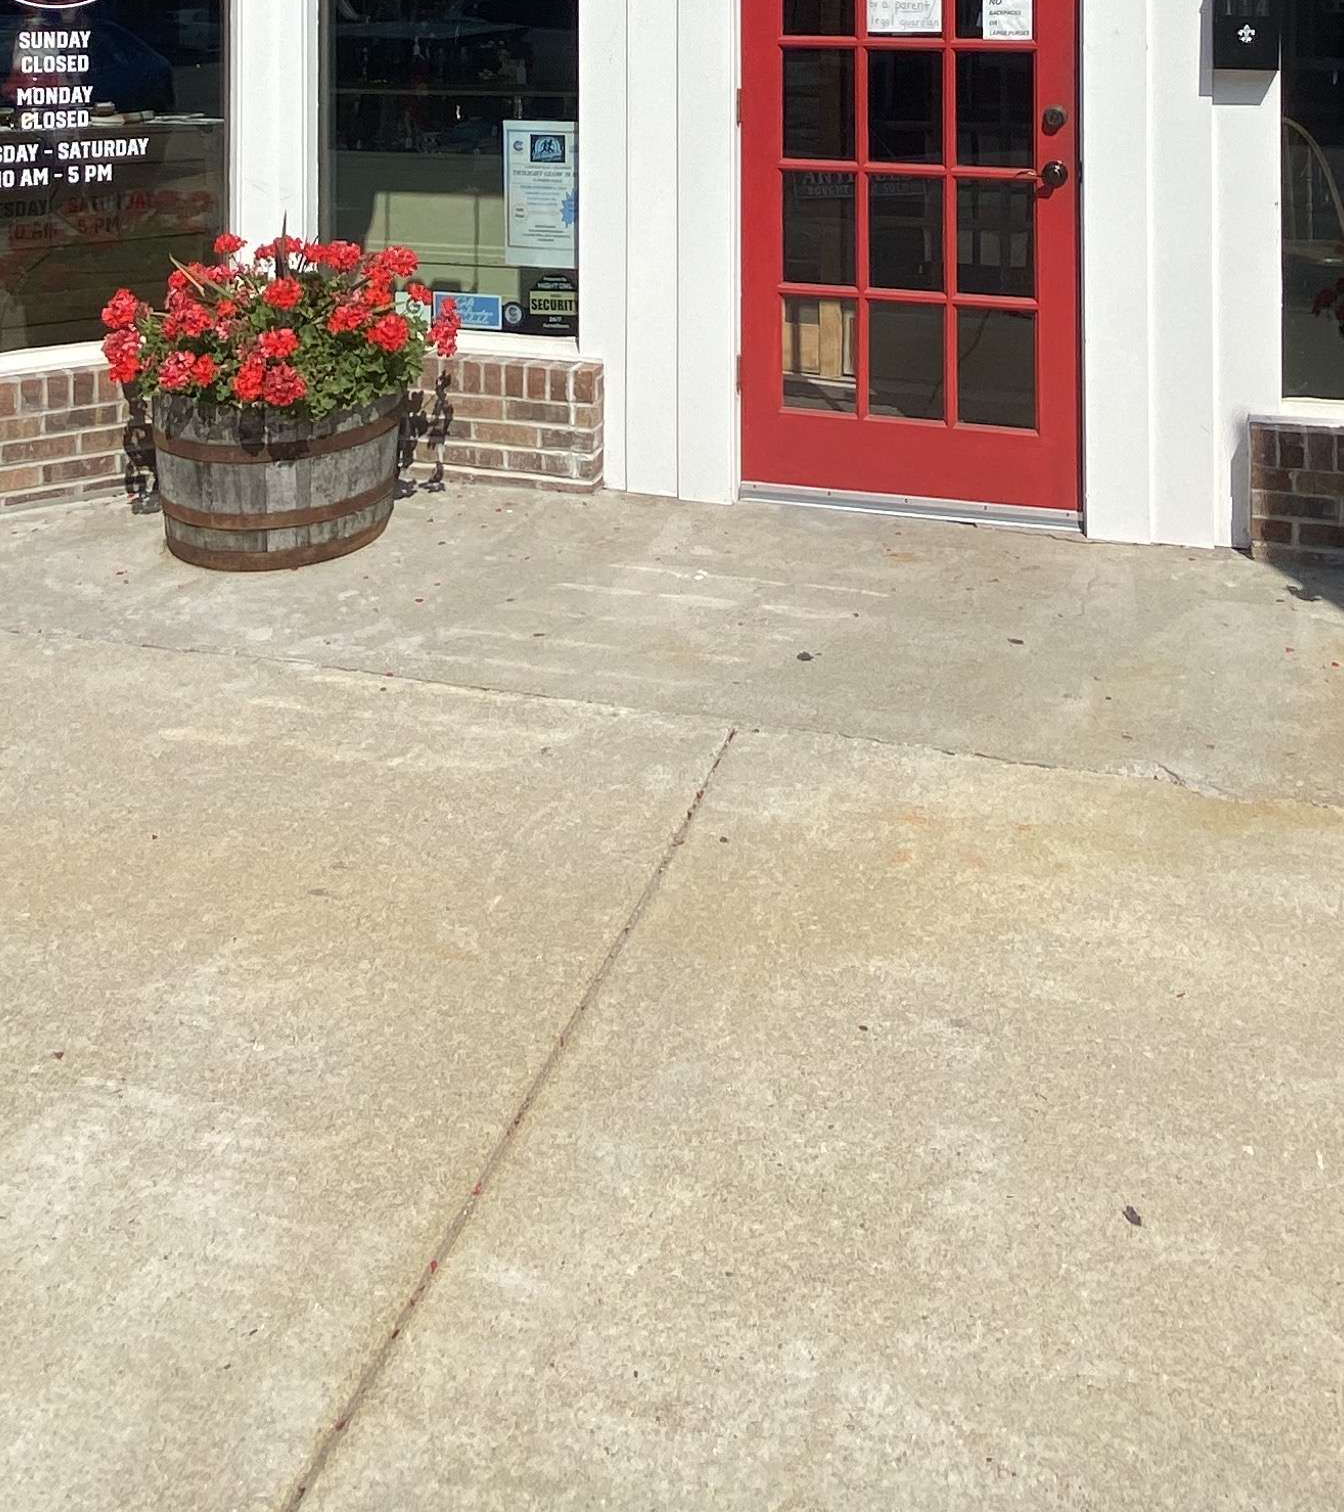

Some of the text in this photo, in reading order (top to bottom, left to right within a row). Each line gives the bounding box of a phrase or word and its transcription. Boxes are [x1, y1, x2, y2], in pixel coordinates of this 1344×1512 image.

[18, 30, 91, 49] SUNDAY
[21, 54, 89, 74] CLOSED
[16, 85, 93, 106] MONDAY
[21, 109, 89, 130] CLOSED
[57, 138, 149, 160] SATURDAY
[20, 167, 49, 187] AM
[68, 165, 80, 185] 5
[84, 164, 113, 183] PM
[531, 298, 577, 312] SECURIT
